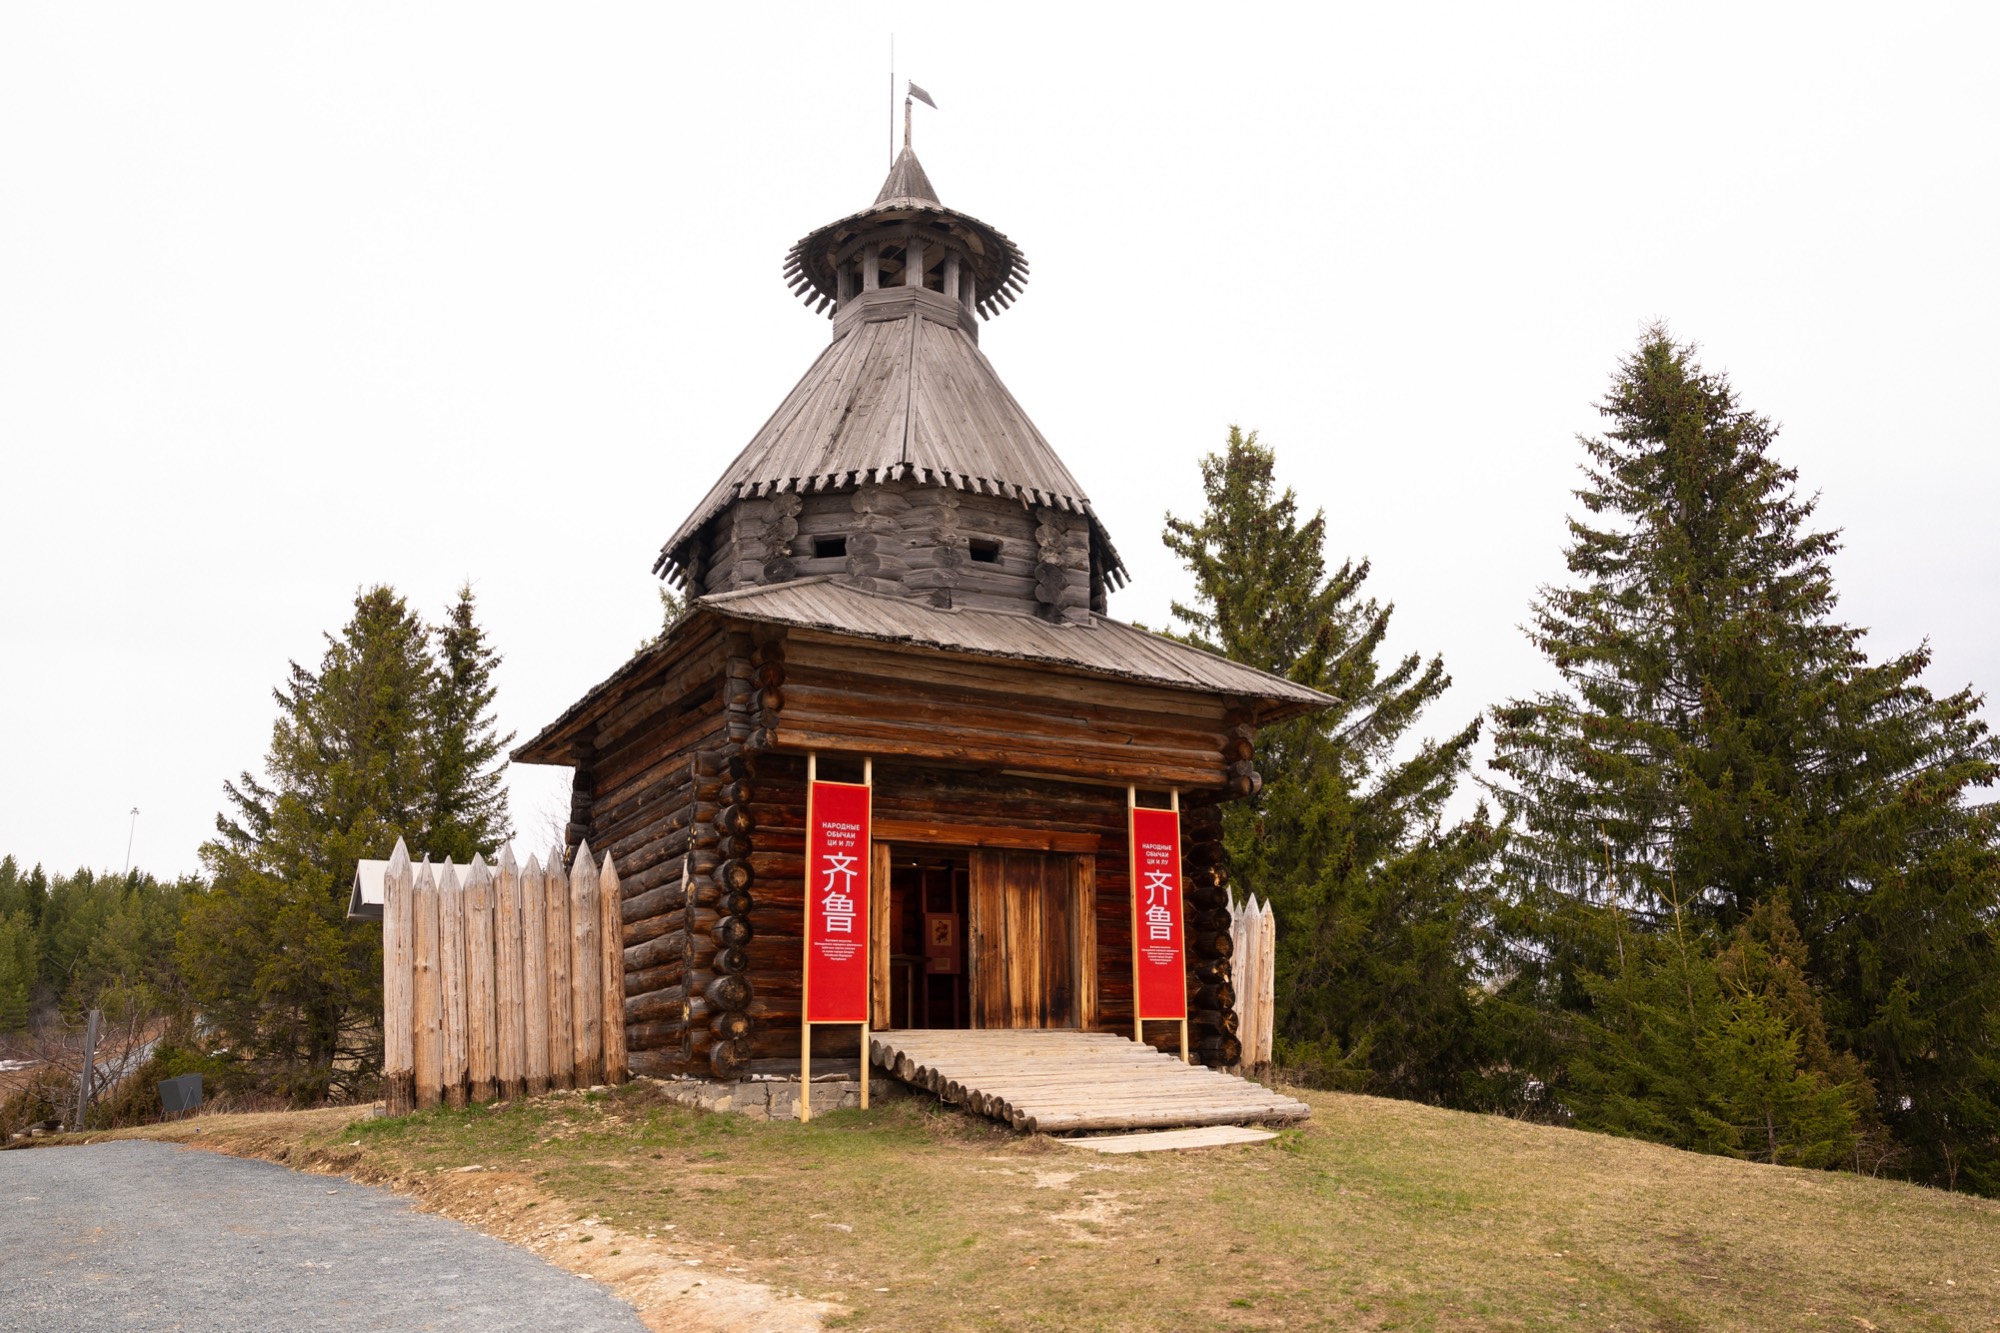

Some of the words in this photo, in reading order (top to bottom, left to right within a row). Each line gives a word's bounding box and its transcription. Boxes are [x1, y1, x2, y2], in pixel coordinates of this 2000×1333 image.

[822, 822, 860, 831] НАРОДНЫЕ
[826, 830, 856, 839] ОБЫЧАИ
[827, 839, 838, 847] ЦИ
[845, 840, 855, 848] ЛУ
[1142, 843, 1172, 851] НАРОДНЫЕ
[822, 851, 858, 933] 齐鲁
[1144, 869, 1173, 940] 齐鲁
